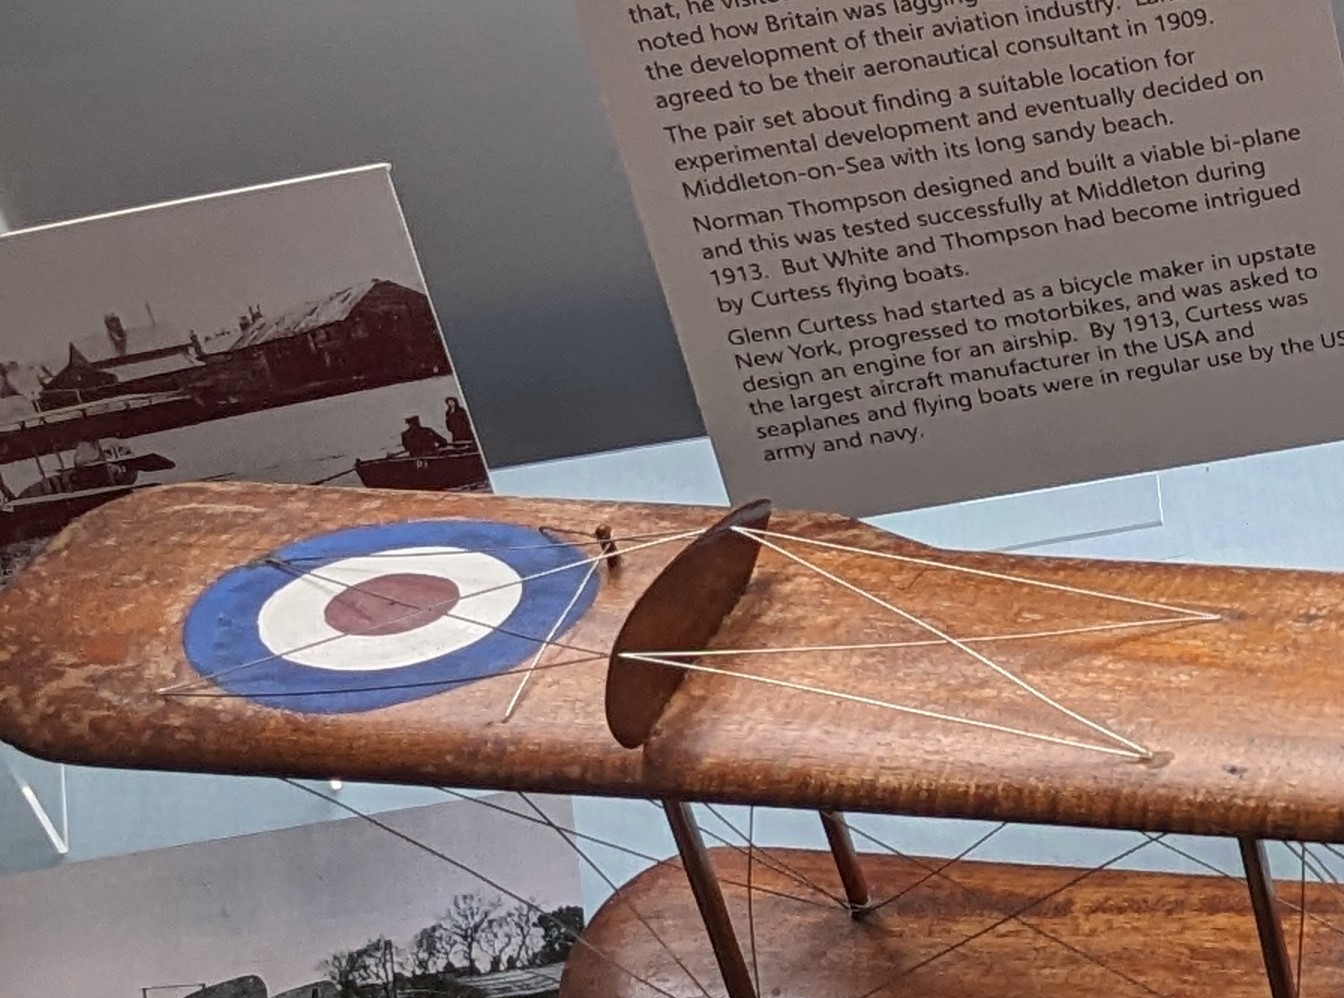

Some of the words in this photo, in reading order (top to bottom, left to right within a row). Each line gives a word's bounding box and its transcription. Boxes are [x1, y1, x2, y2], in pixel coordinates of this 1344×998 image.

[681, 155, 886, 200] Middleton-on-Sea
[888, 143, 938, 167] with
[942, 140, 971, 160] its
[973, 134, 1026, 155] long
[1031, 119, 1096, 146] sandy
[1100, 107, 1174, 135] beach.
[691, 207, 784, 233] Norman
[786, 188, 907, 218] Thompson
[912, 167, 1013, 200] designed
[1019, 159, 1061, 184] and
[1065, 151, 1117, 176] built
[1122, 153, 1135, 167] a
[1139, 138, 1205, 164] viable
[1209, 127, 1301, 153] bi-plane
[715, 295, 744, 316] by
[750, 284, 832, 308] Curtess
[835, 273, 898, 299] flying
[901, 262, 970, 285] boats.
[755, 411, 861, 440] seaplanes
[867, 399, 907, 422] and
[911, 393, 973, 417] flying
[976, 382, 1038, 405] boats
[1041, 374, 1094, 394] were
[1098, 367, 1120, 385] in
[1125, 356, 1201, 382] regular
[1206, 350, 1243, 368] use
[1247, 343, 1274, 363] by
[1279, 336, 1315, 356] the
[763, 441, 816, 462] army
[821, 429, 863, 452] and
[868, 425, 924, 446] navy.
